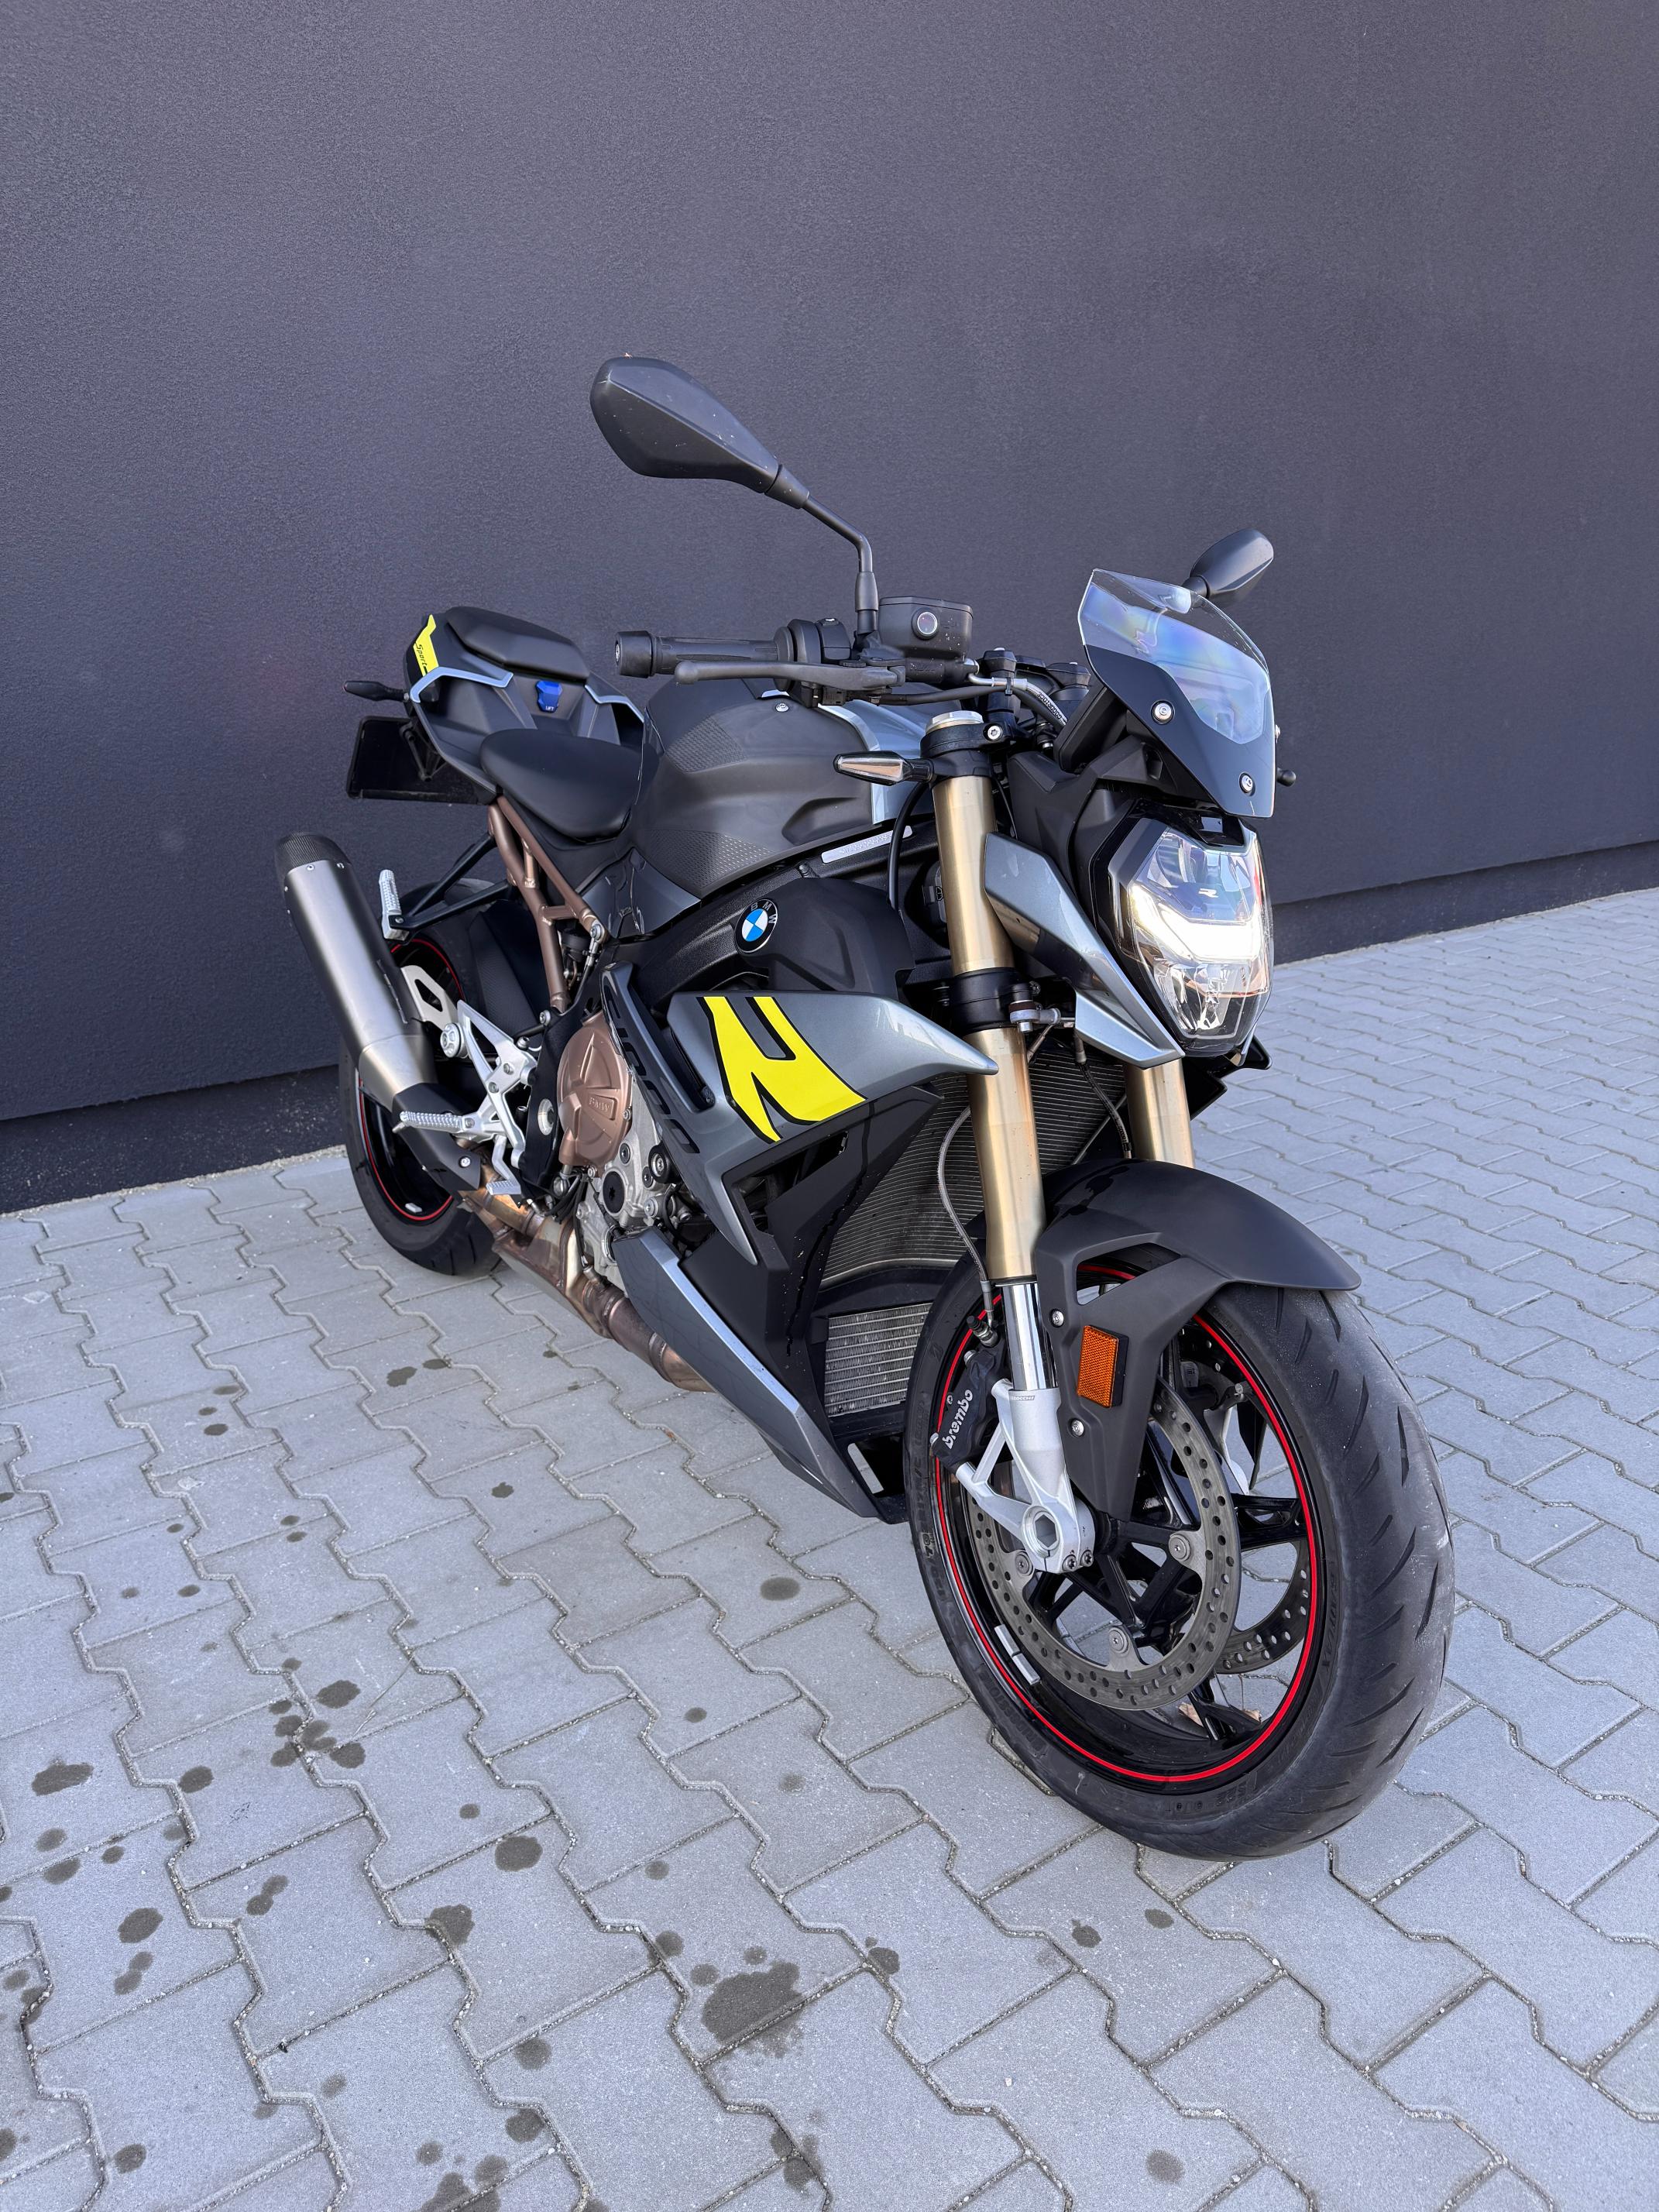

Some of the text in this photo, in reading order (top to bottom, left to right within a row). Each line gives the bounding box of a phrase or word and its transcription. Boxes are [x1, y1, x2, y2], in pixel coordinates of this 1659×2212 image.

[415, 643, 428, 667] Sport
[589, 1097, 610, 1113] BMW
[942, 1389, 974, 1449] brembo
